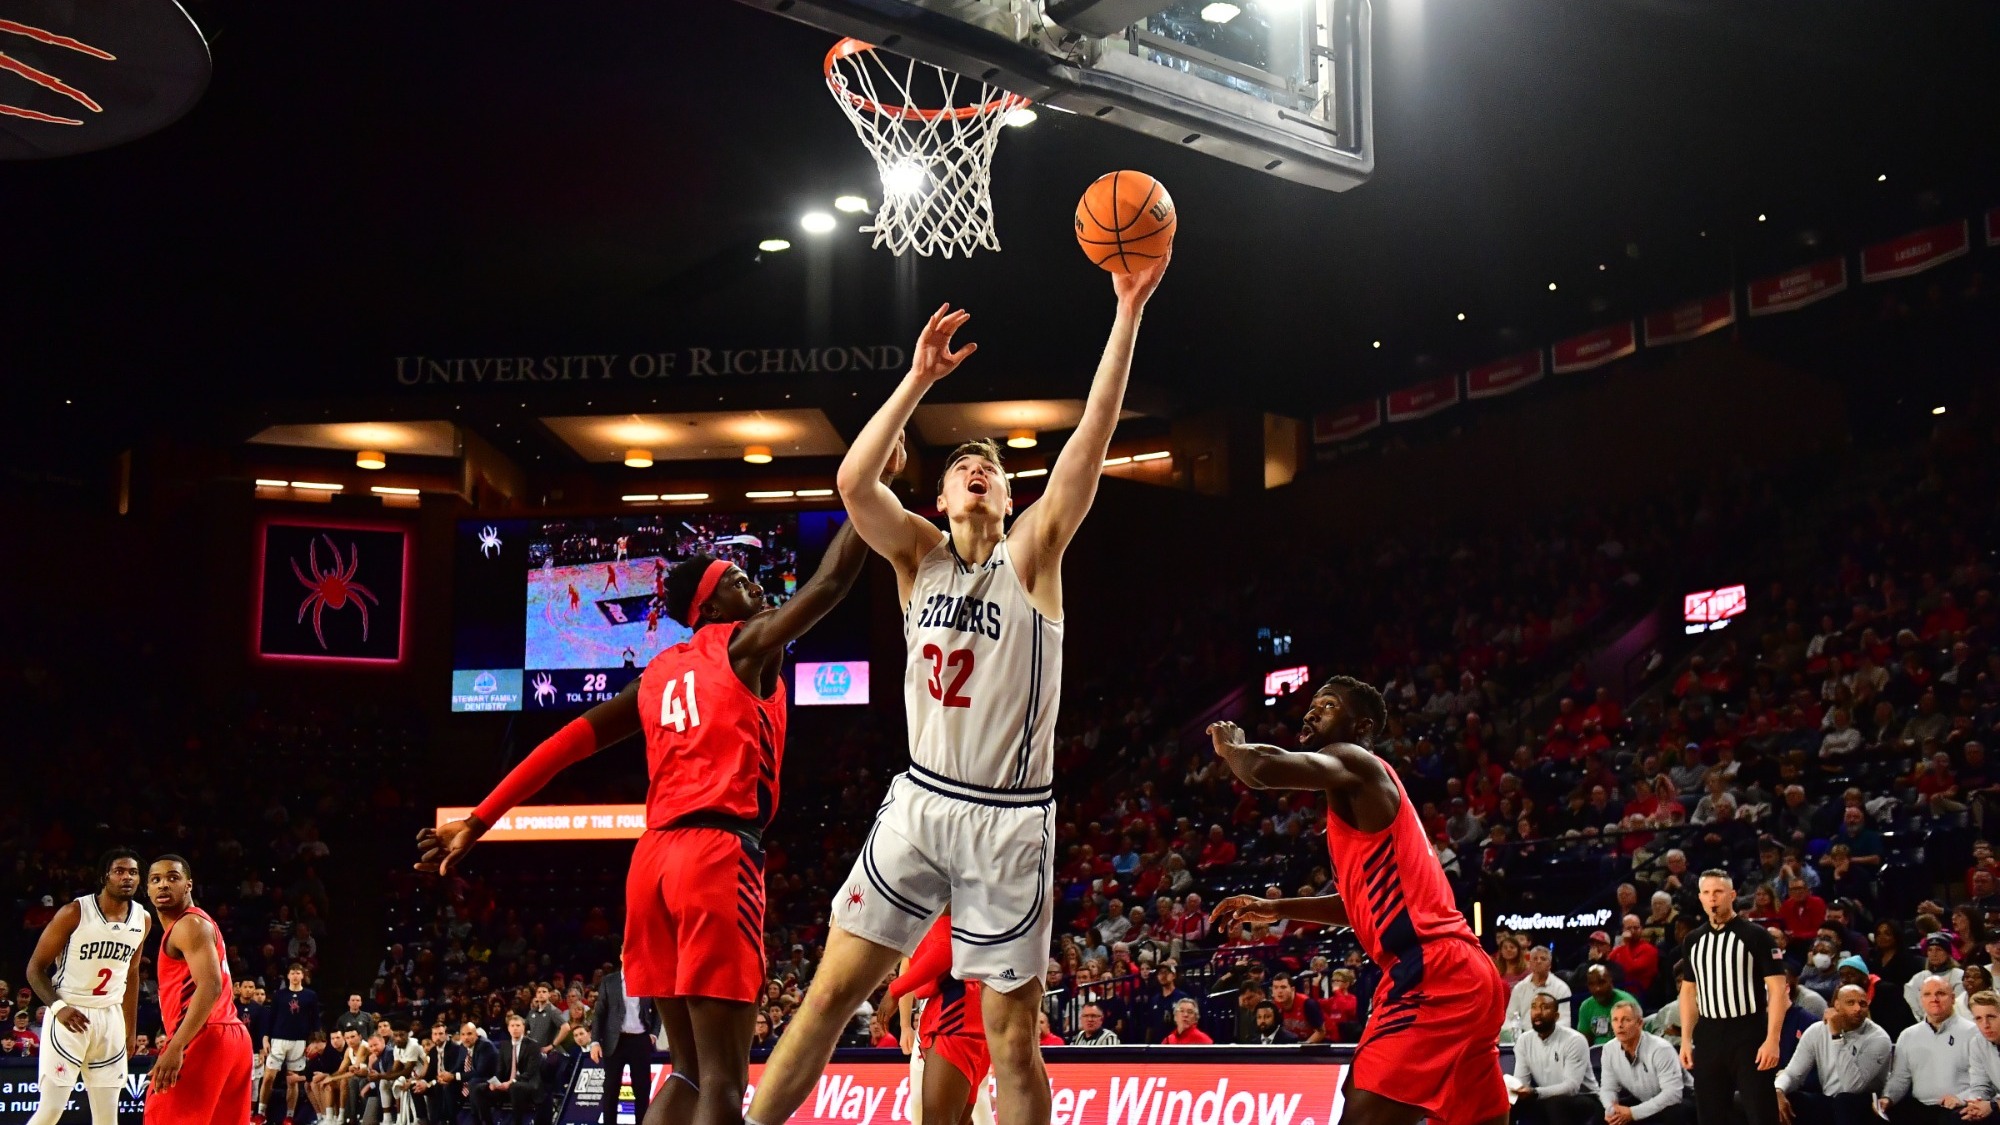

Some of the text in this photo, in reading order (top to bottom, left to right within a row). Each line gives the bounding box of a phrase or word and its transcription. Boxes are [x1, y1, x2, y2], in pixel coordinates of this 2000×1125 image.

[396, 345, 906, 385] UNIVERSITY OF RICHMOND
[583, 674, 608, 692] 28
[922, 643, 975, 708] 32
[453, 694, 518, 703] STEWART FAMILY
[566, 693, 583, 702] TOL
[587, 693, 592, 702] 2
[597, 692, 612, 702] FLS
[661, 670, 700, 732] 41
[464, 702, 507, 711] DENTISTRY
[515, 816, 570, 830] SPONSOR
[573, 816, 588, 830] OF
[590, 815, 613, 829] THE
[616, 815, 646, 829] FOUL
[92, 968, 113, 995] 2
[2, 1082, 13, 1094] a
[814, 1075, 887, 1125] Way
